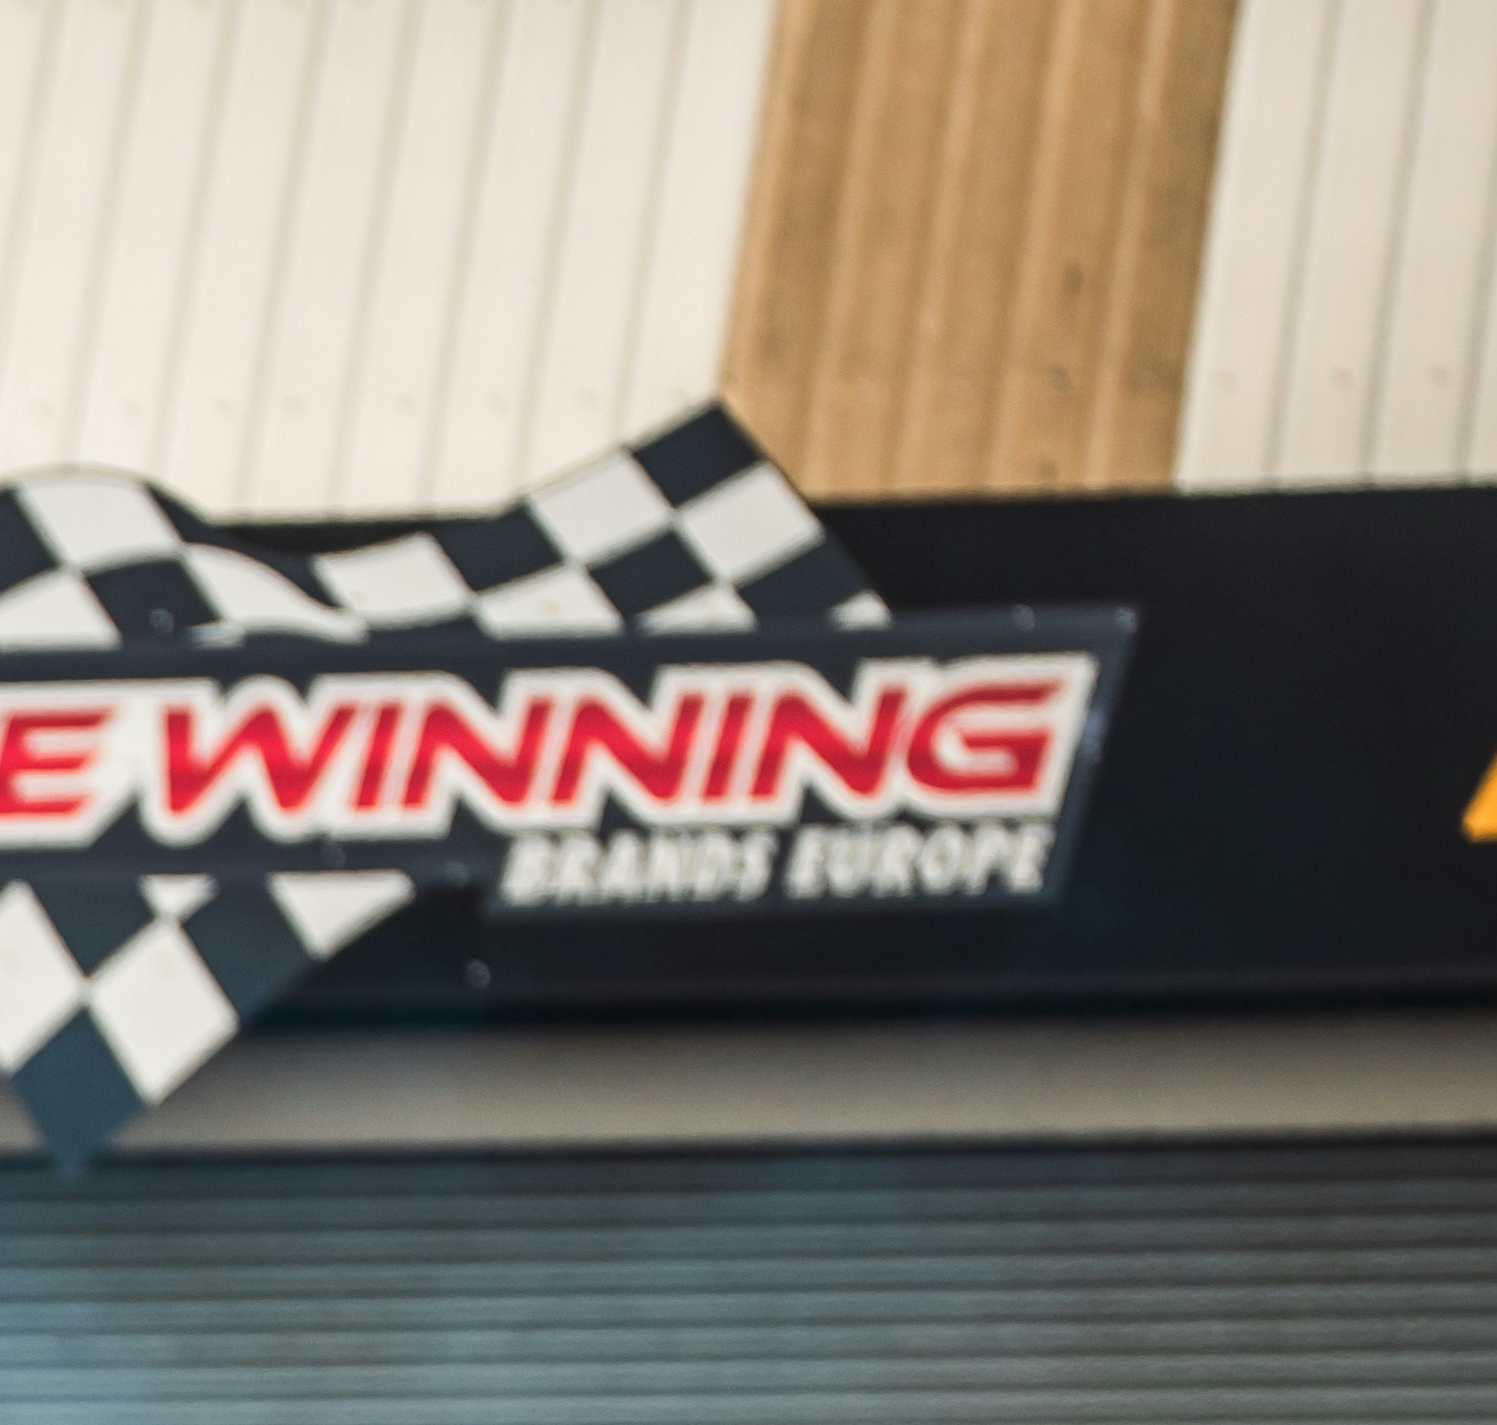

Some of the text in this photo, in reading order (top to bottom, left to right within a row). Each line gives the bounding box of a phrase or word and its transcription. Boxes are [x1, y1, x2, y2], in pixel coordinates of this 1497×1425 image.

[155, 676, 1066, 818] WINNING
[500, 818, 1055, 907] BRANDS EUROPE
